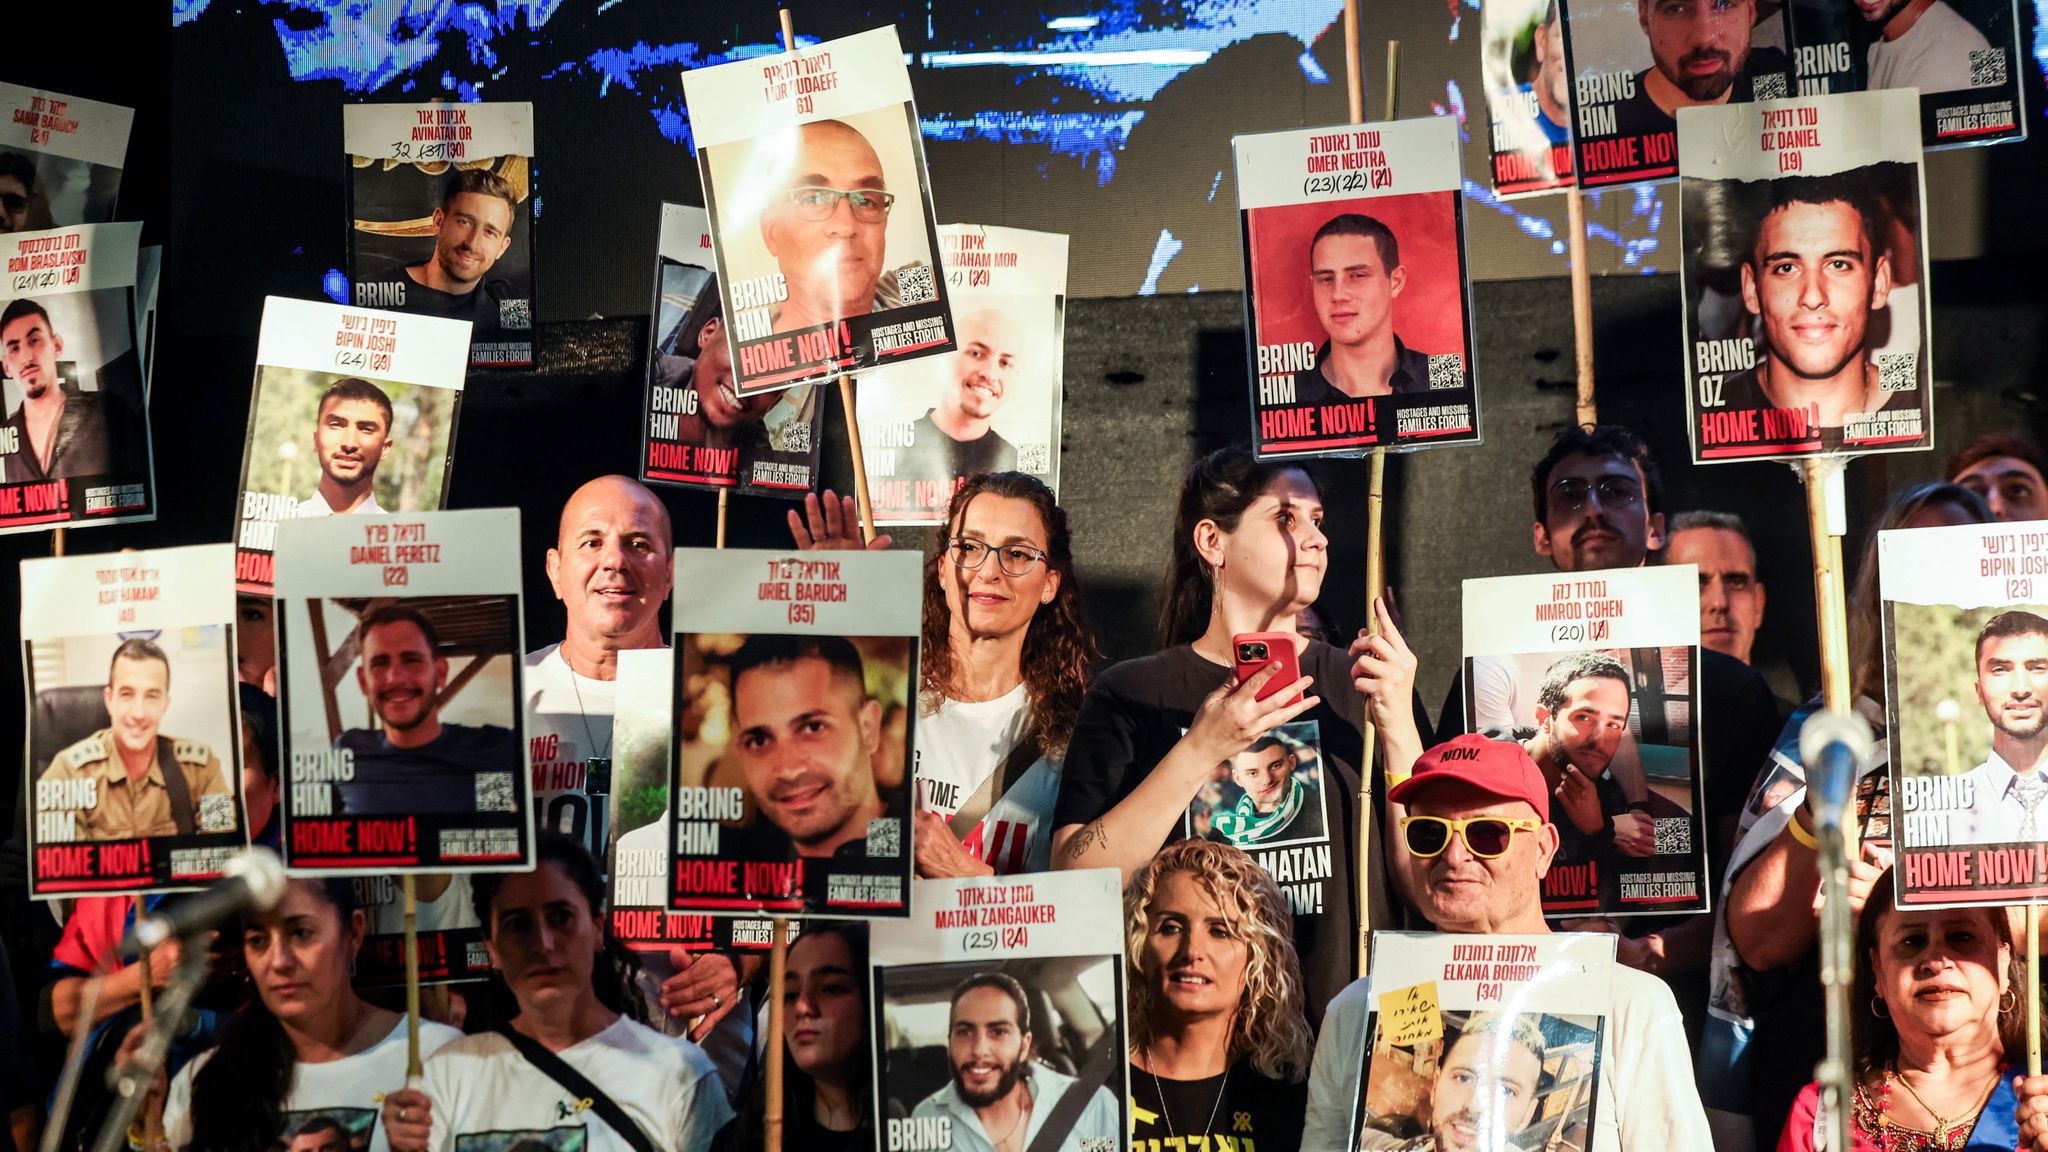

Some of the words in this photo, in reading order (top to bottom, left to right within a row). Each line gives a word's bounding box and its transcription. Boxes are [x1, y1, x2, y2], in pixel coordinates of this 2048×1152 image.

[801, 52, 832, 75] ליאור
[1576, 69, 1636, 107] BRING
[42, 114, 78, 135] BARUCH
[416, 110, 433, 124] אור
[437, 110, 466, 124] אבינתן
[1579, 105, 1617, 138] HIM
[1762, 110, 1794, 130] דניאל
[1797, 108, 1817, 126] עוז
[1937, 114, 1979, 135] FAMILIES
[1980, 111, 2014, 128] FORUM
[411, 126, 457, 141] AVINATAN
[459, 126, 472, 140] OR
[1310, 134, 1350, 153] נאוטרה
[1353, 131, 1381, 149] עומר
[1761, 133, 1776, 151] OZ
[1778, 129, 1821, 149] DANIEL
[391, 142, 411, 158] 32
[1307, 156, 1339, 173] OMER
[1342, 150, 1386, 170] NEUTRA
[1582, 136, 1640, 173] HOME
[1778, 151, 1803, 173] (19)
[961, 235, 985, 250] איתן
[8, 257, 28, 273] ROM
[31, 250, 86, 270] BRASLAVSKI
[995, 252, 1018, 267] MOR
[355, 282, 406, 306] BRING
[730, 272, 788, 312] BRING
[735, 308, 773, 342] HIM
[871, 323, 902, 339] HOSTAGES
[902, 321, 916, 333] AND
[916, 316, 943, 330] MISSING
[336, 331, 364, 349] BIPIN
[366, 335, 396, 353] JOSHI
[740, 337, 796, 376] HOME
[797, 321, 852, 364] NOW!
[873, 333, 914, 351] FAMILIES
[914, 326, 947, 346] FORUM
[472, 350, 505, 363] FAMILIES
[506, 350, 532, 362] FORUM
[1258, 342, 1315, 374] BRING
[1696, 337, 1756, 373] BRING
[652, 385, 698, 415] BRING
[1259, 375, 1296, 405] HIM
[1699, 375, 1726, 408] OZ
[1261, 407, 1316, 439] HOME
[1321, 398, 1375, 435] NOW!
[1397, 408, 1427, 419] HOSTAGES
[1428, 407, 1440, 418] AND
[1441, 404, 1469, 416] MISSING
[650, 414, 680, 440] HIM
[1397, 416, 1437, 433] FAMILIES
[1438, 414, 1469, 430] FORUM
[1701, 409, 1760, 445] HOME
[1763, 402, 1821, 440] NOW!
[1843, 422, 1885, 440] FAMILIES
[1886, 420, 1922, 437] FORUM
[648, 442, 690, 471] HOME
[693, 447, 739, 476] NOW!
[752, 470, 784, 485] FAMILIES
[784, 472, 810, 487] FORUM
[242, 491, 299, 520] BRING
[239, 520, 276, 550] HIM
[392, 523, 426, 542] דניאל
[350, 546, 392, 565] DANIEL
[395, 544, 441, 564] PERETZ
[236, 552, 275, 583] HOM
[383, 566, 408, 587] (22)
[1981, 557, 2015, 577] BIPIN
[758, 583, 792, 601] URIEL
[796, 583, 847, 602] BARUCH
[1552, 583, 1571, 602] כהן
[1575, 581, 1607, 598] נמרוד
[2006, 578, 2033, 600] (23)
[788, 604, 815, 624] (35)
[1536, 603, 1581, 621] NIMROD
[1586, 600, 1623, 619] COHEN
[1551, 624, 1585, 643] (20)
[292, 748, 355, 782] BRING
[36, 777, 97, 811] BRING
[292, 783, 332, 816] HIM
[678, 787, 743, 821] BRING
[1902, 775, 1975, 811] BRING
[36, 811, 76, 844] HIM
[292, 820, 353, 854] HOME
[357, 815, 417, 853] NOW!
[677, 821, 719, 856] HIM
[1904, 814, 1949, 847] HIM
[36, 845, 94, 879] HOME
[99, 837, 152, 876] NOW!
[616, 850, 667, 877] BRING
[1258, 845, 1332, 883] MATAN
[1905, 851, 1973, 888] HOME
[1978, 843, 2048, 886] NOW!
[677, 860, 738, 894] HOME
[744, 859, 804, 896] NOW!
[1545, 860, 1598, 897] NOW!
[1620, 873, 1651, 884] HOSTAGES
[1652, 873, 1665, 883] AND
[1666, 872, 1695, 882] MISSING
[614, 878, 649, 906] HIM
[956, 887, 1006, 907] צנגאוקר
[1011, 885, 1034, 903] מתן
[1620, 883, 1662, 899] FAMILIES
[1663, 882, 1696, 897] FORUM
[613, 911, 662, 939] HOME
[732, 920, 761, 930] HOSTAGES
[762, 921, 774, 930] AND
[935, 909, 977, 929] MATAN
[981, 904, 1056, 926] ZANGAUKER
[732, 930, 769, 944] FAMILIES
[962, 930, 998, 951] (25)
[1453, 944, 1493, 962] בוחבוט
[1497, 944, 1536, 963] אלקנה
[1443, 964, 1489, 981] ELKANA
[1476, 983, 1502, 1002] (34)
[888, 1116, 951, 1152] BRING
